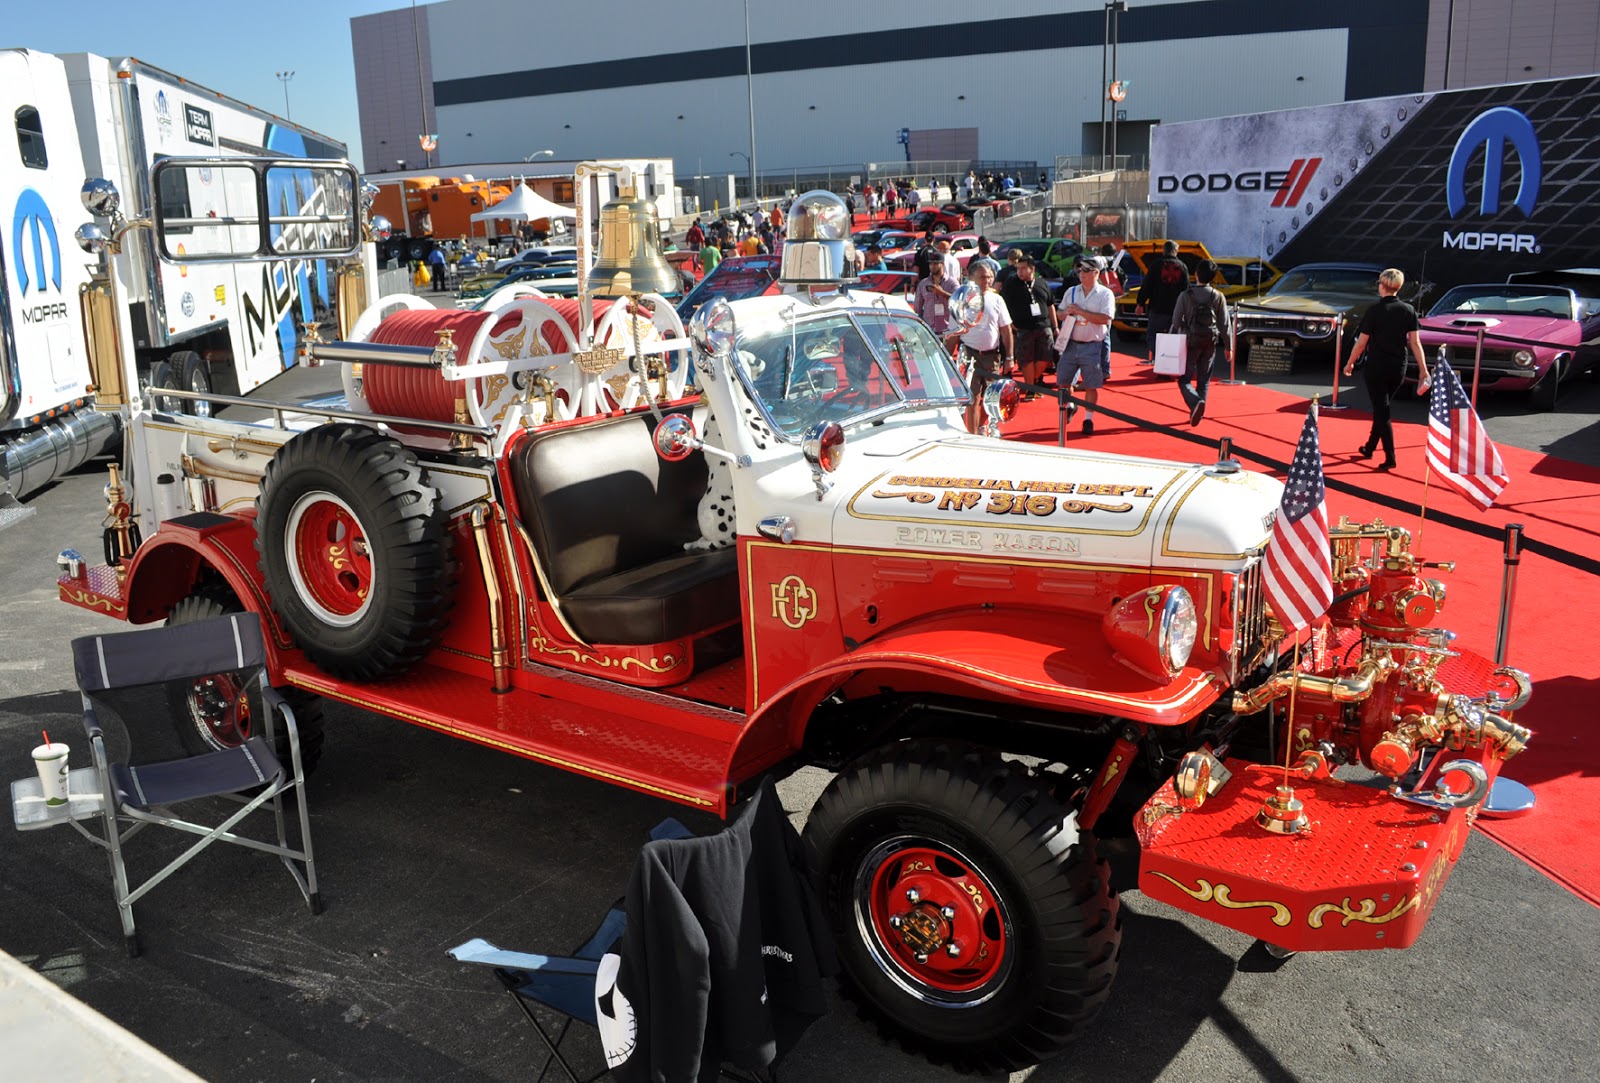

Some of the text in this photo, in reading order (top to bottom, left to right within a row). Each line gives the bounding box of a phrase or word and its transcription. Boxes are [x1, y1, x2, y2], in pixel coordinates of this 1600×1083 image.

[188, 109, 208, 127] TEAM
[188, 123, 213, 142] MOPAR
[1158, 171, 1291, 193] DODGE
[22, 302, 68, 325] MOPAR
[888, 475, 1154, 498] CORDELIA FIRE DEPT.
[987, 492, 1058, 516] 316
[895, 526, 1081, 556] POWER WAGON
